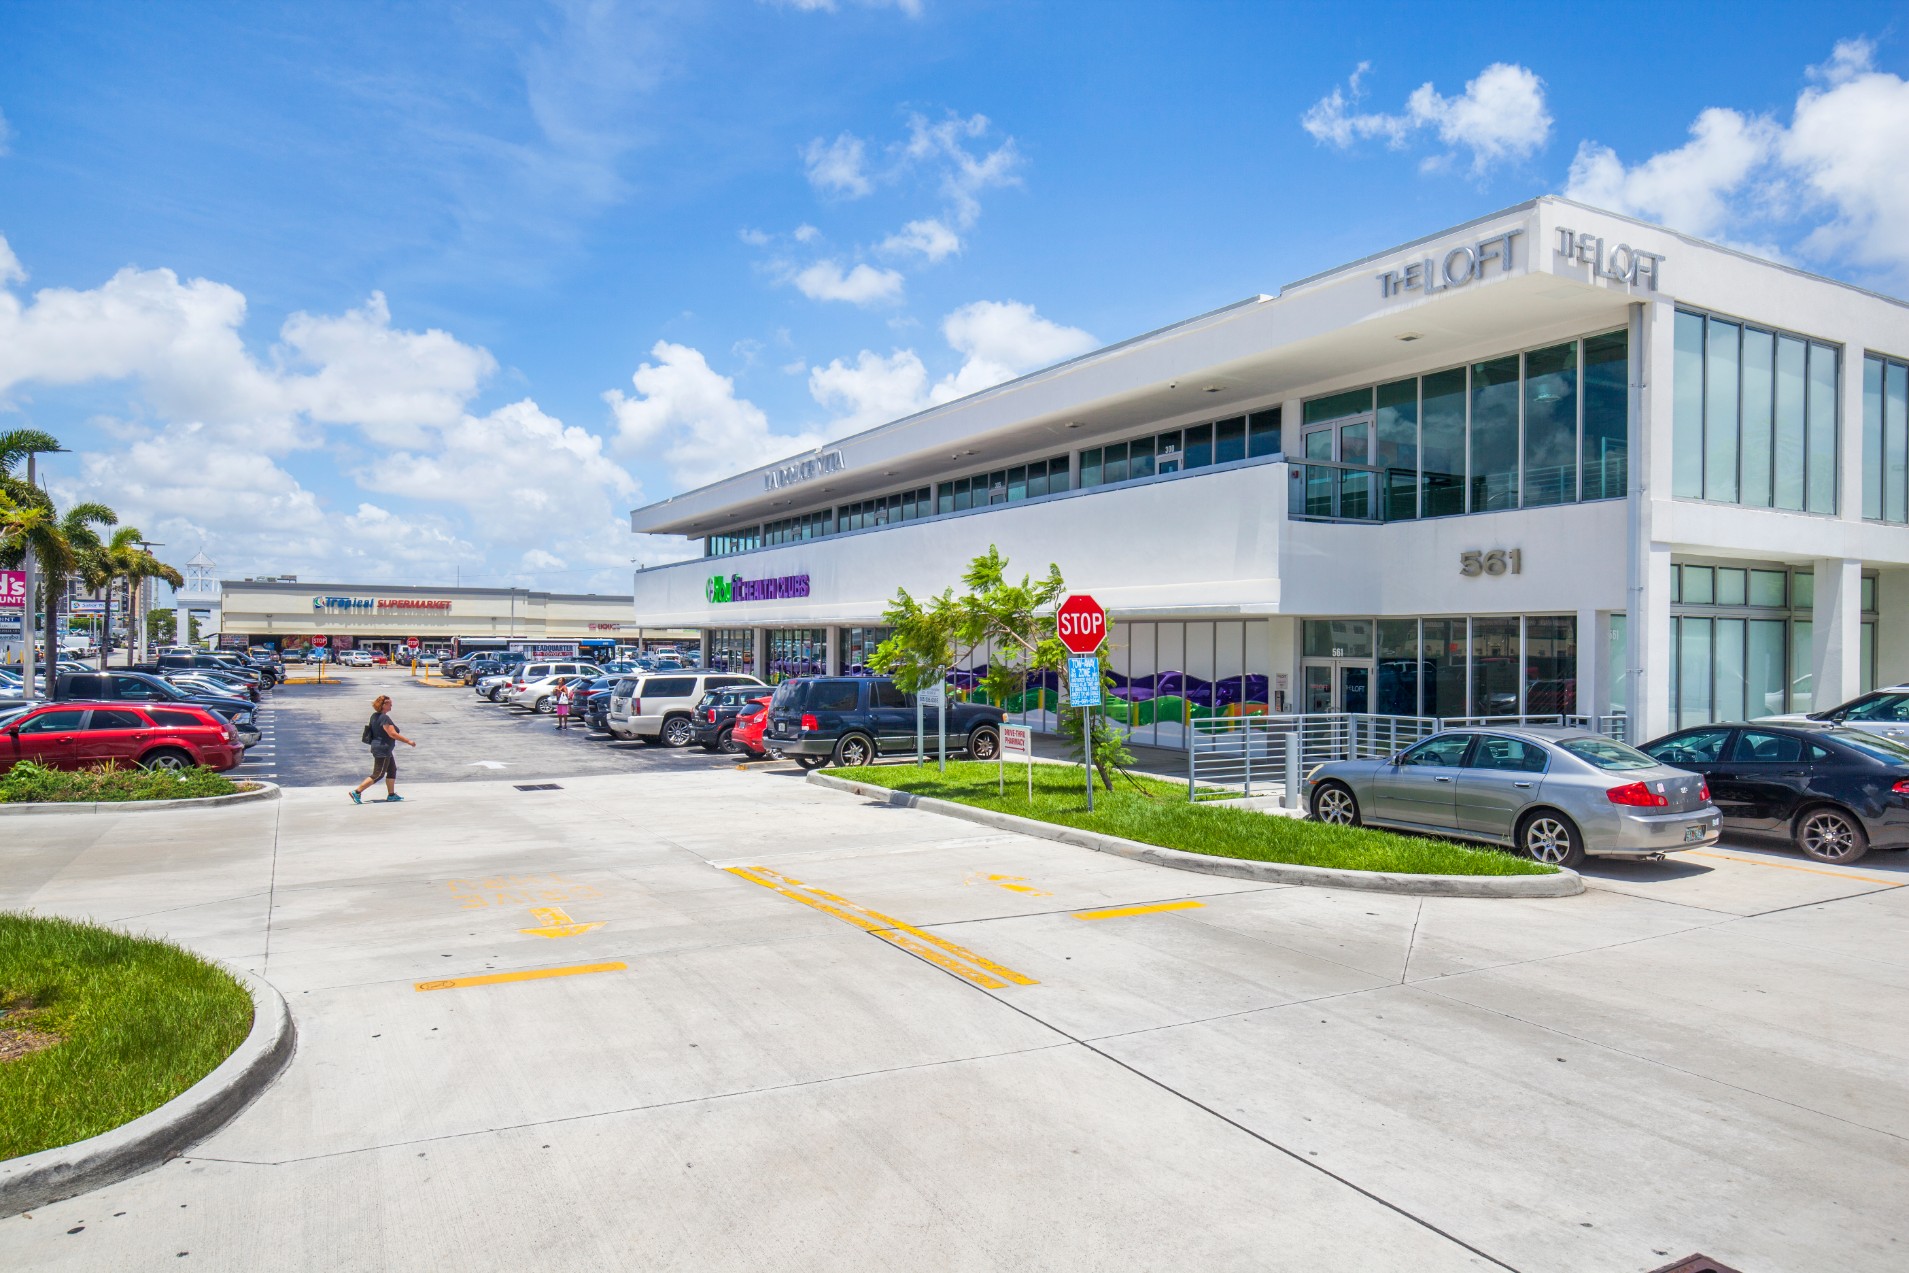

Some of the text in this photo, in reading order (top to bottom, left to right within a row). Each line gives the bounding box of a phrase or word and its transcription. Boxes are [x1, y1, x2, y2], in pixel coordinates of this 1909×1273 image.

[1376, 228, 1524, 298] THE LOFT
[1555, 226, 1666, 292] THE LOFT
[1459, 549, 1522, 577] 561
[743, 578, 778, 601] HEALTH
[778, 574, 811, 599] CLUBS
[325, 597, 453, 610] Tropical SUPERMARKET
[1061, 613, 1103, 635] STOP
[1332, 648, 1344, 657] 561
[1004, 729, 1026, 738] DRIVE-THRU
[1004, 737, 1025, 746] PHARMACY
